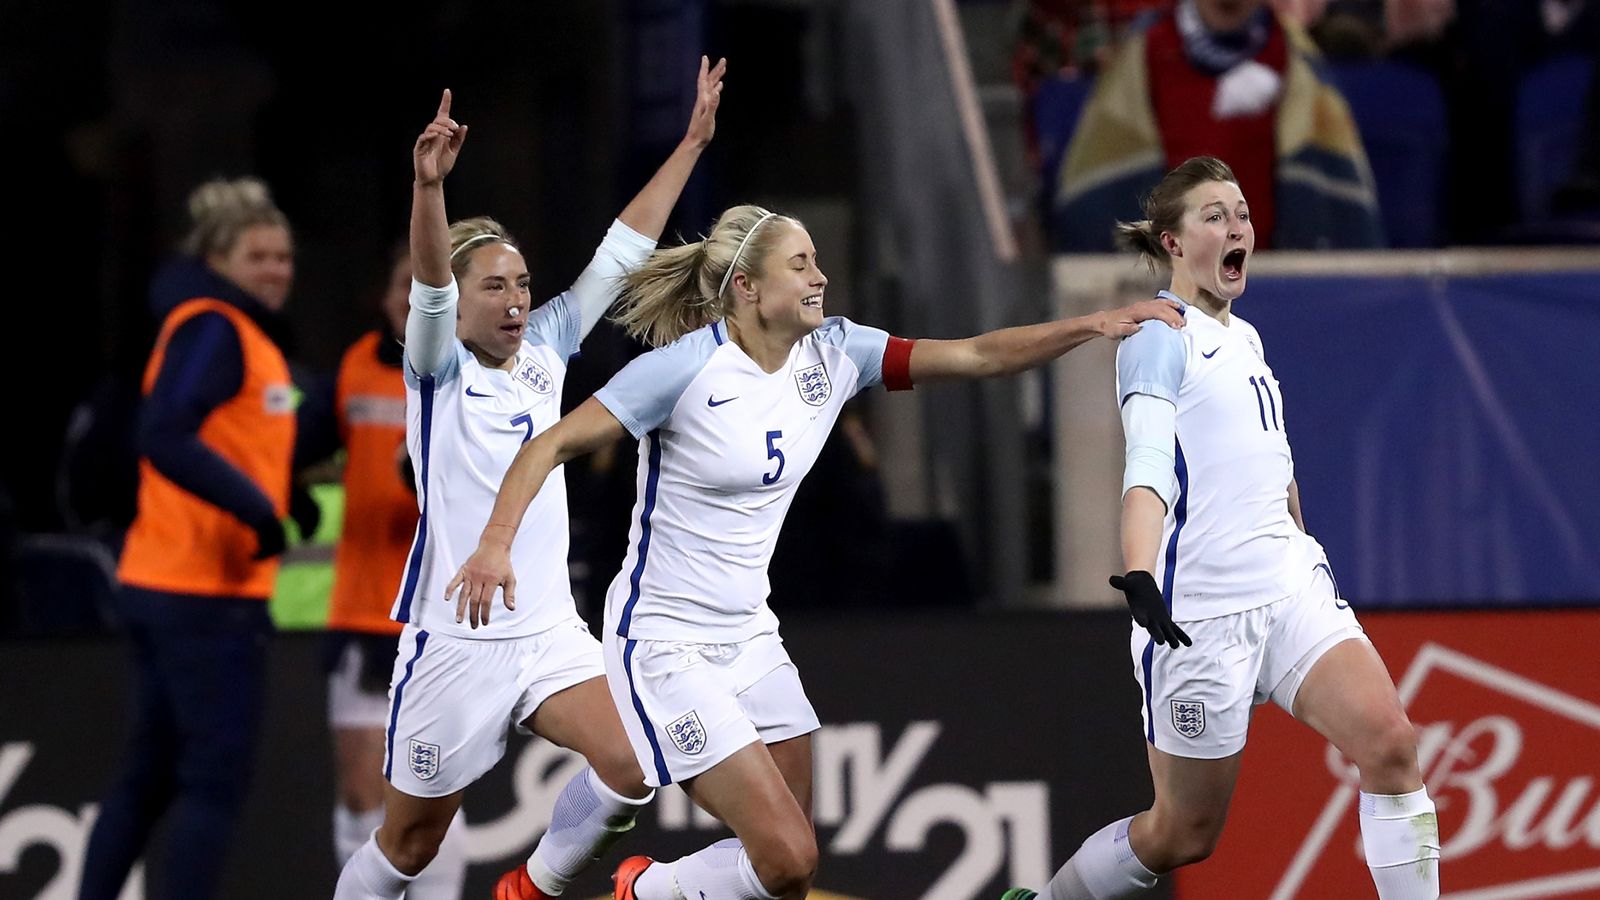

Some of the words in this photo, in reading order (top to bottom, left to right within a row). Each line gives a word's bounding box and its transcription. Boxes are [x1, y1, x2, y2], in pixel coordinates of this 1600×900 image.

[509, 412, 534, 445] 7
[1248, 375, 1280, 431] 11
[762, 430, 785, 485] 5
